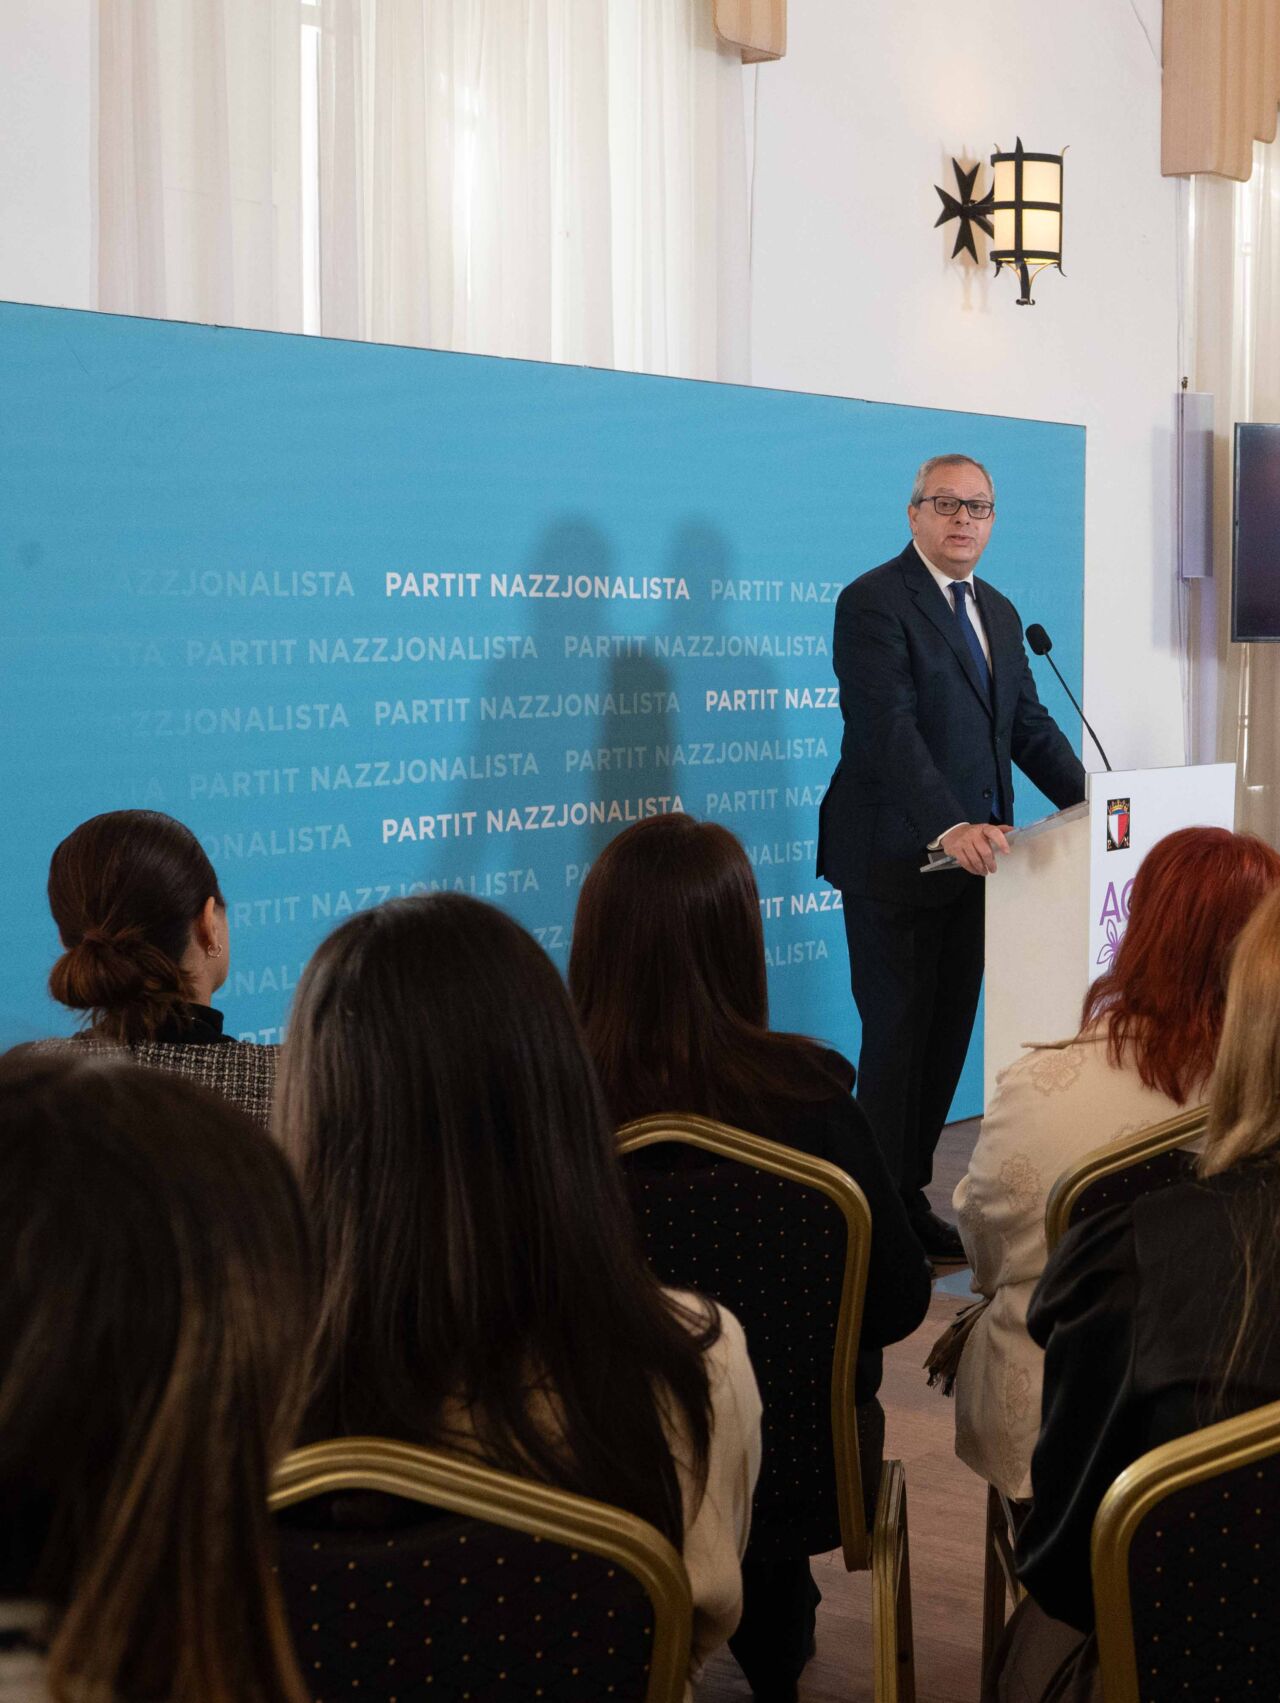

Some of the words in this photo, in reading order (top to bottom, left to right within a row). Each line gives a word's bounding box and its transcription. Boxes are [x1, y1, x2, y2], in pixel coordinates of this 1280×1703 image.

[385, 572, 481, 598] PARTIT
[490, 573, 690, 600] NAZZJONALISTA
[711, 579, 784, 603] PARTIT
[185, 639, 297, 667] PARTIT
[308, 636, 538, 664] NAZZJONALISTA
[564, 635, 647, 659] PARTIT
[654, 635, 828, 658] NAZZJONALISTA
[374, 697, 470, 726] PARTIT
[480, 691, 680, 721] NAZZJONALISTA
[706, 688, 779, 712] PARTIT
[189, 768, 300, 799] PARTIT
[310, 752, 539, 792] NAZZJONALISTA
[565, 746, 647, 772] PARTIT
[654, 738, 828, 768] NAZZJONALISTA
[381, 811, 477, 844] PARTIT
[486, 795, 685, 835] NAZZJONALISTA
[706, 788, 779, 814] PARTIT
